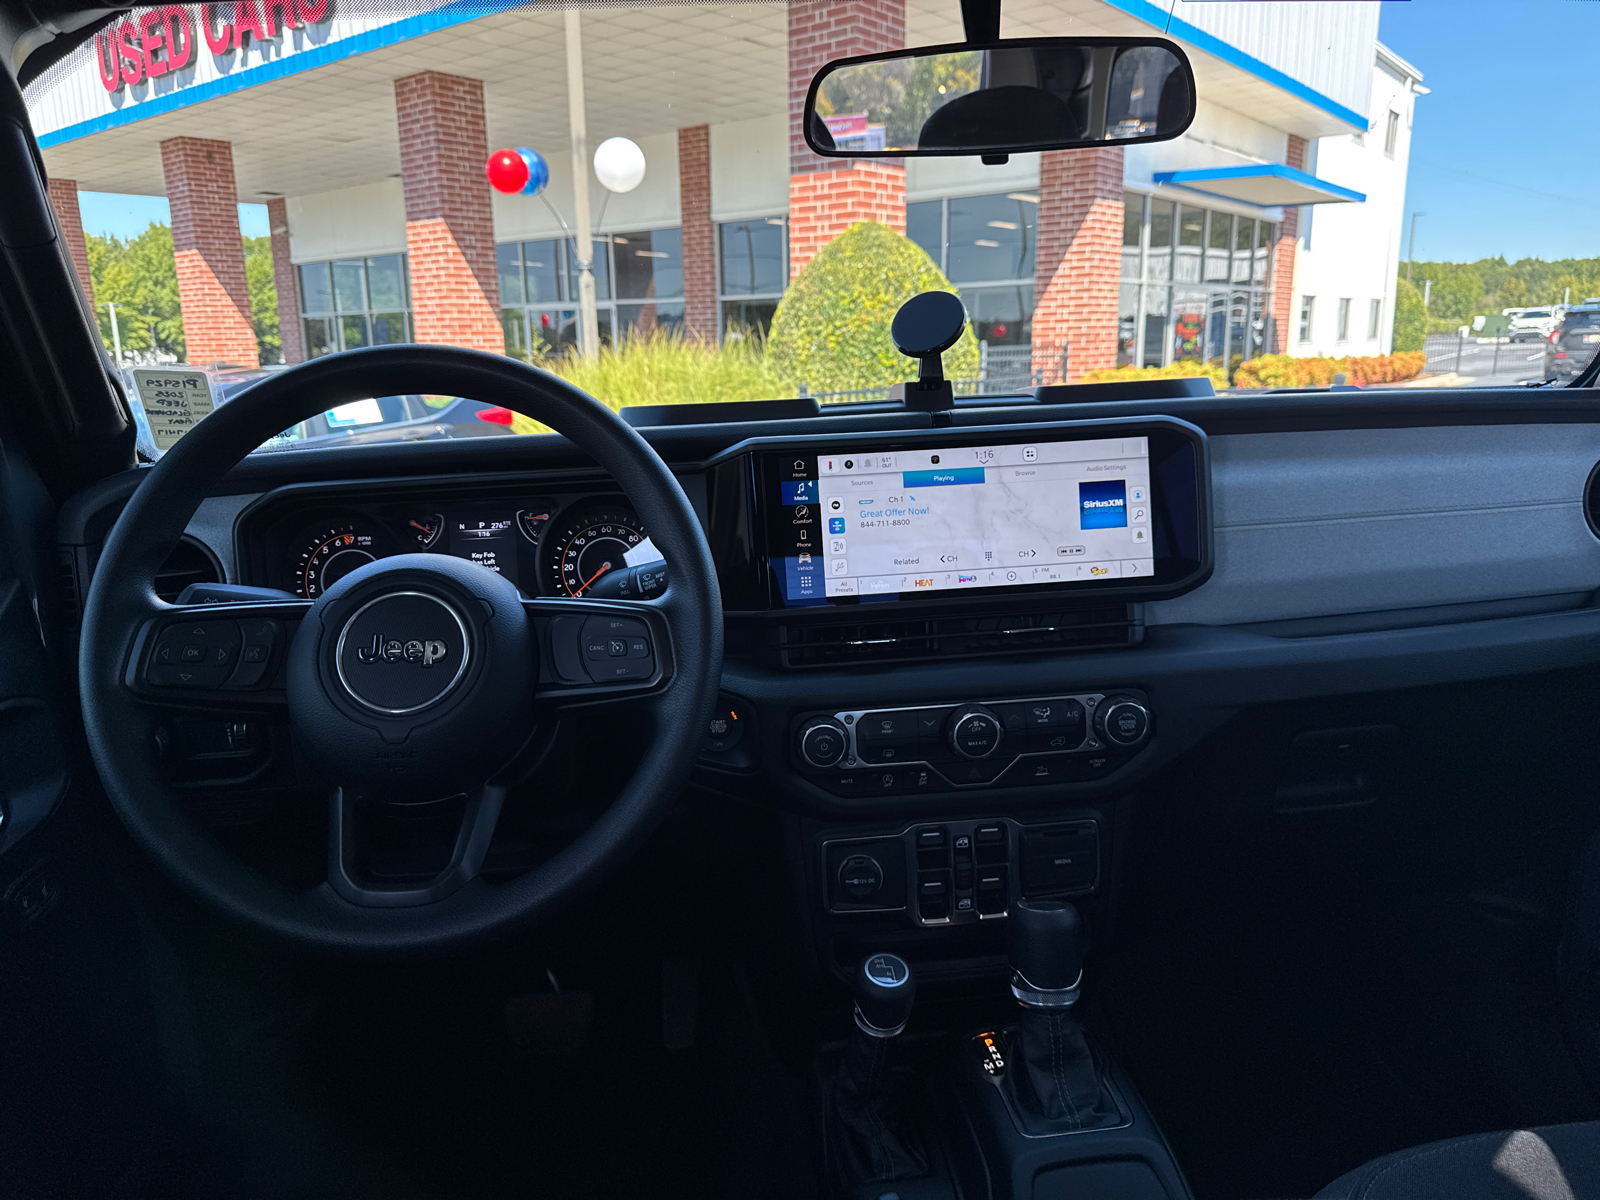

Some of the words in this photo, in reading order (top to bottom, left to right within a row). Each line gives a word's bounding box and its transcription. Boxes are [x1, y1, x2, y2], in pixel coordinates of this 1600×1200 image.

[96, 4, 191, 93] USED
[975, 450, 994, 460] 1:16
[1103, 464, 1127, 472] Settings
[888, 495, 899, 503] Ch
[1083, 499, 1124, 509] SiriusXM
[860, 509, 883, 519] Great
[884, 508, 906, 518] Offer
[907, 506, 930, 516] Now!
[479, 521, 485, 529] P
[860, 519, 910, 528] 844-711-8800
[600, 525, 612, 533] 60
[322, 545, 329, 554] 5
[1018, 550, 1030, 558] CH
[313, 557, 319, 565] 4
[893, 558, 920, 566] Related
[309, 570, 315, 579] 3
[914, 579, 934, 587] HEAT
[309, 584, 316, 593] 2
[187, 648, 200, 656] OK
[358, 634, 447, 665] Jeep
[1066, 710, 1079, 718] A/C
[988, 1045, 998, 1053] R
[991, 1052, 1002, 1060] N
[983, 1062, 995, 1070] M
[995, 1060, 1005, 1068] D
